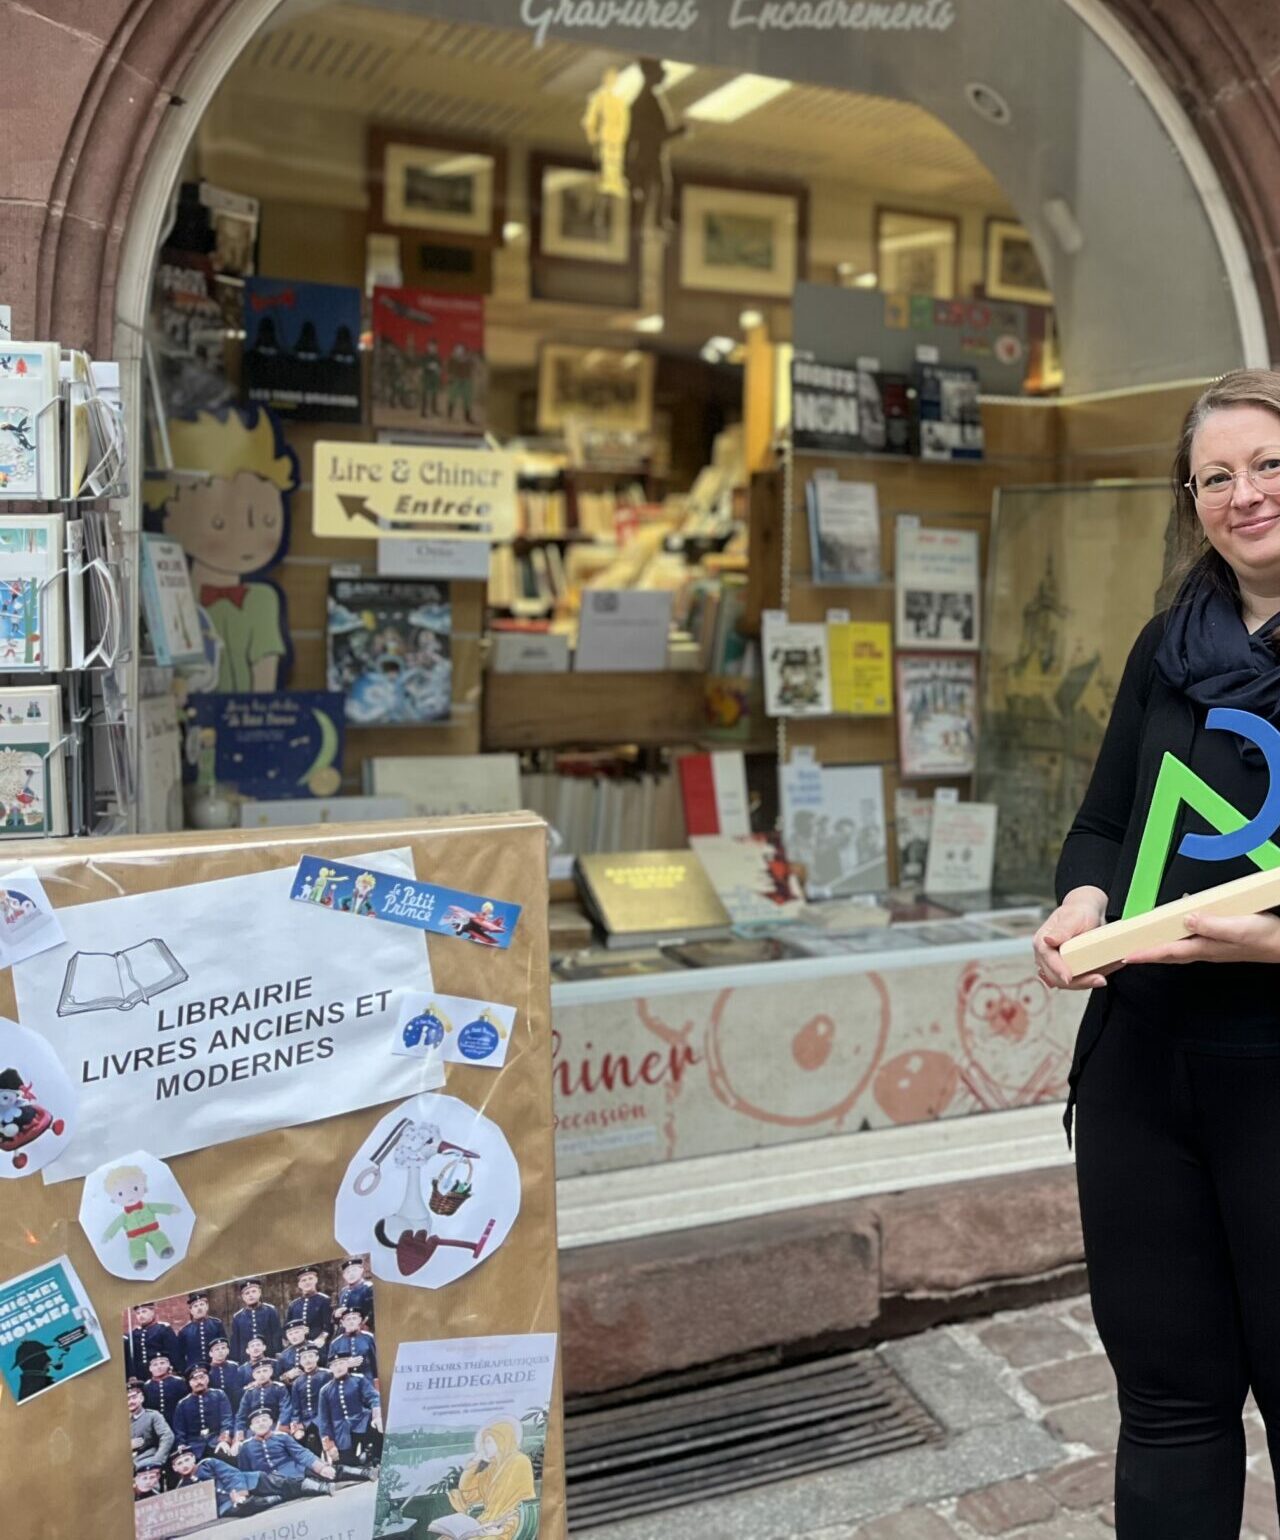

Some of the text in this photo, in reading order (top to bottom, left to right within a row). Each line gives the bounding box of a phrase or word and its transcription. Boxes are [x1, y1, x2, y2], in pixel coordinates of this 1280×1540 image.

[520, 0, 957, 49] Gravures Encadrements
[329, 456, 503, 487] Lire & Chiner
[394, 494, 492, 517] Entrée
[381, 894, 432, 922] Prince
[389, 883, 435, 911] Le Petit
[157, 976, 313, 1032] LIBRAIRIE
[82, 989, 393, 1083] LIVRES ANCIENS ET
[156, 1036, 334, 1101] MODERNES
[552, 1029, 703, 1097] hiner
[0, 1281, 59, 1317] NIGMES
[0, 1294, 67, 1332] HERLOCK
[406, 1369, 537, 1391] DE HILDEGARDE
[415, 1360, 462, 1373] TRÉSORS
